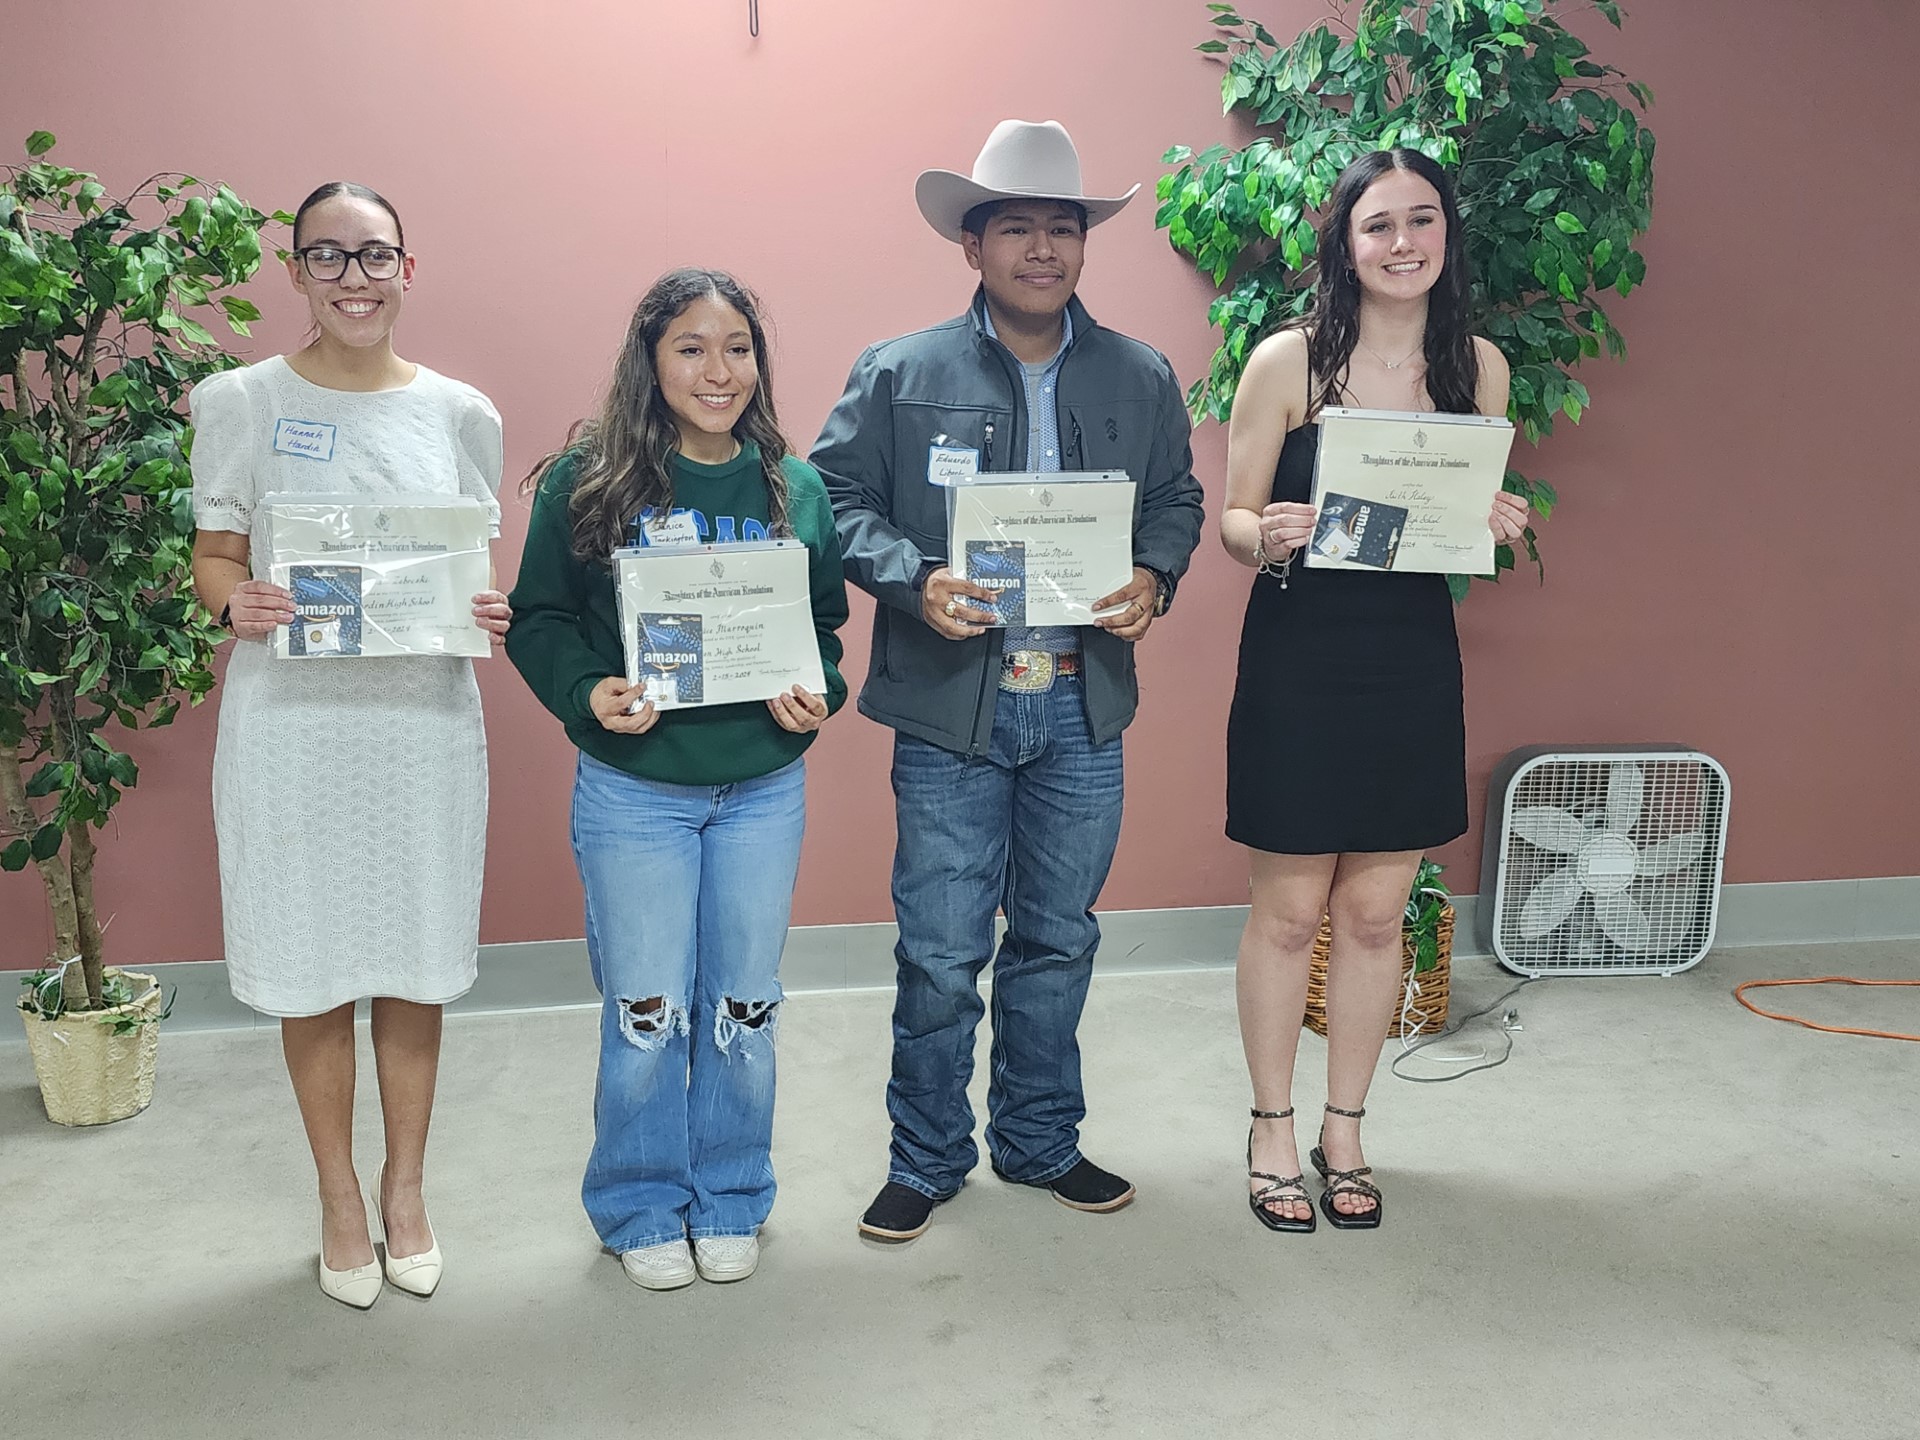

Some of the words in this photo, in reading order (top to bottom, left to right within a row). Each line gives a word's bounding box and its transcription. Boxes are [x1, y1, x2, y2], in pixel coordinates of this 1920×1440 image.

[284, 425, 323, 440] Hannah
[935, 453, 971, 464] Eduardo
[1360, 453, 1394, 467] Daughters
[1410, 456, 1439, 467] American
[1439, 458, 1470, 468] Revolution
[1037, 514, 1066, 525] American
[1347, 505, 1371, 557] amazon
[376, 541, 410, 552] American
[971, 578, 1020, 589] amazon
[712, 586, 741, 598] American
[408, 596, 436, 608] School
[295, 604, 355, 616] amazon
[736, 642, 761, 654] School
[643, 652, 697, 664] amazon
